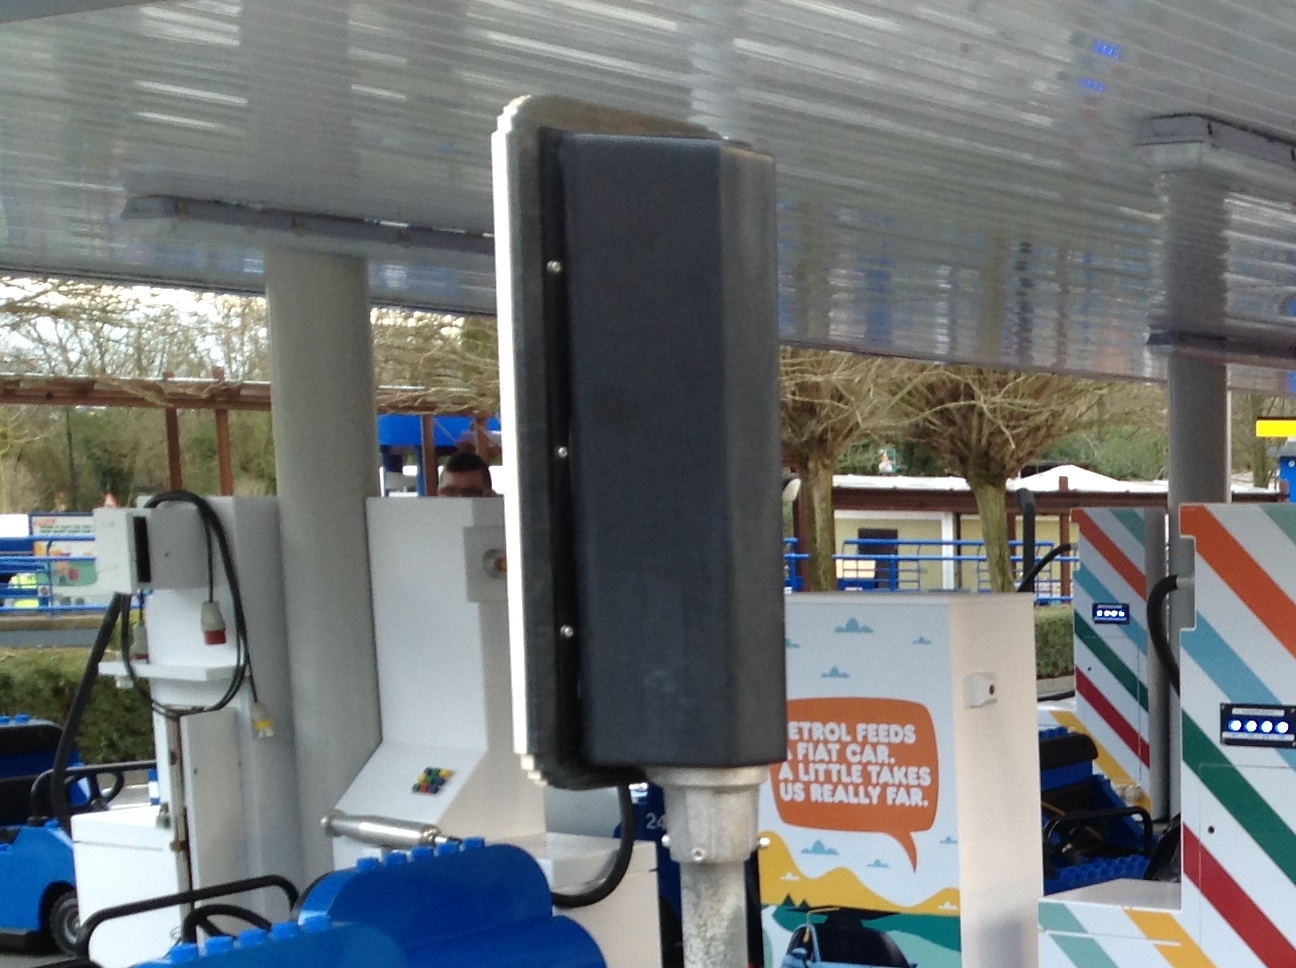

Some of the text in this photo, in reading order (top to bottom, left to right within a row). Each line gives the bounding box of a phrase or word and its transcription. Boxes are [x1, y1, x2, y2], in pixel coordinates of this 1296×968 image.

[787, 721, 916, 744] ETROL FEEDS
[796, 741, 841, 762] FIAT
[845, 743, 896, 764] CAR.
[778, 761, 931, 786] A LITTLE TAKES
[779, 782, 929, 808] US REALLY FAR.
